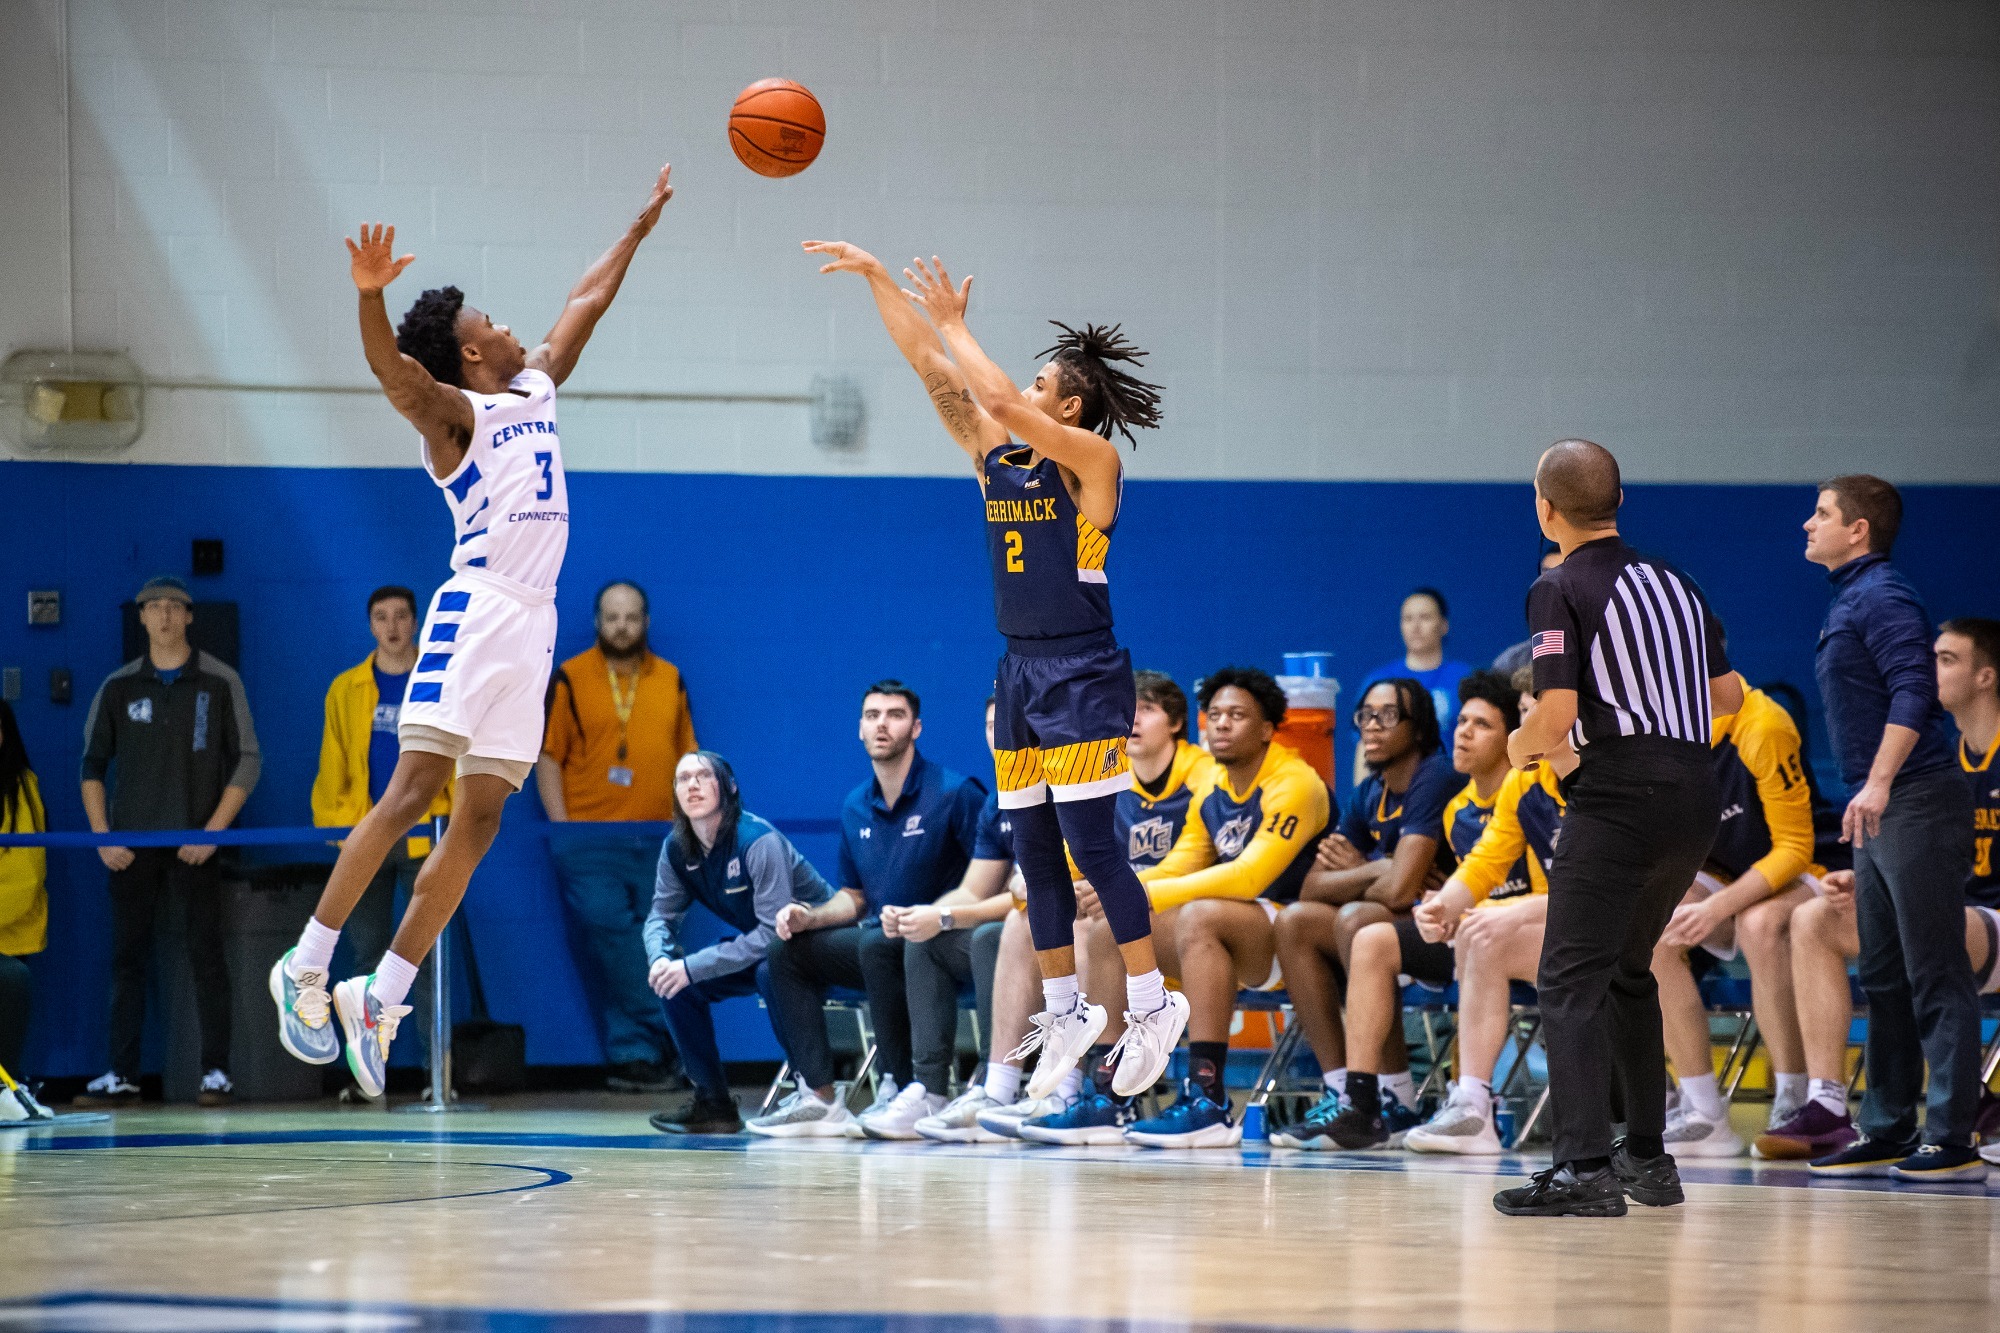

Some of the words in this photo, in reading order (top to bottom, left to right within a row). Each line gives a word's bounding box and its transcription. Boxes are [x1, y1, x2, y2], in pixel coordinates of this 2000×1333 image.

[493, 421, 558, 449] CENTRA
[535, 451, 553, 500] 3
[1004, 530, 1024, 573] 2
[1129, 815, 1174, 860] MC
